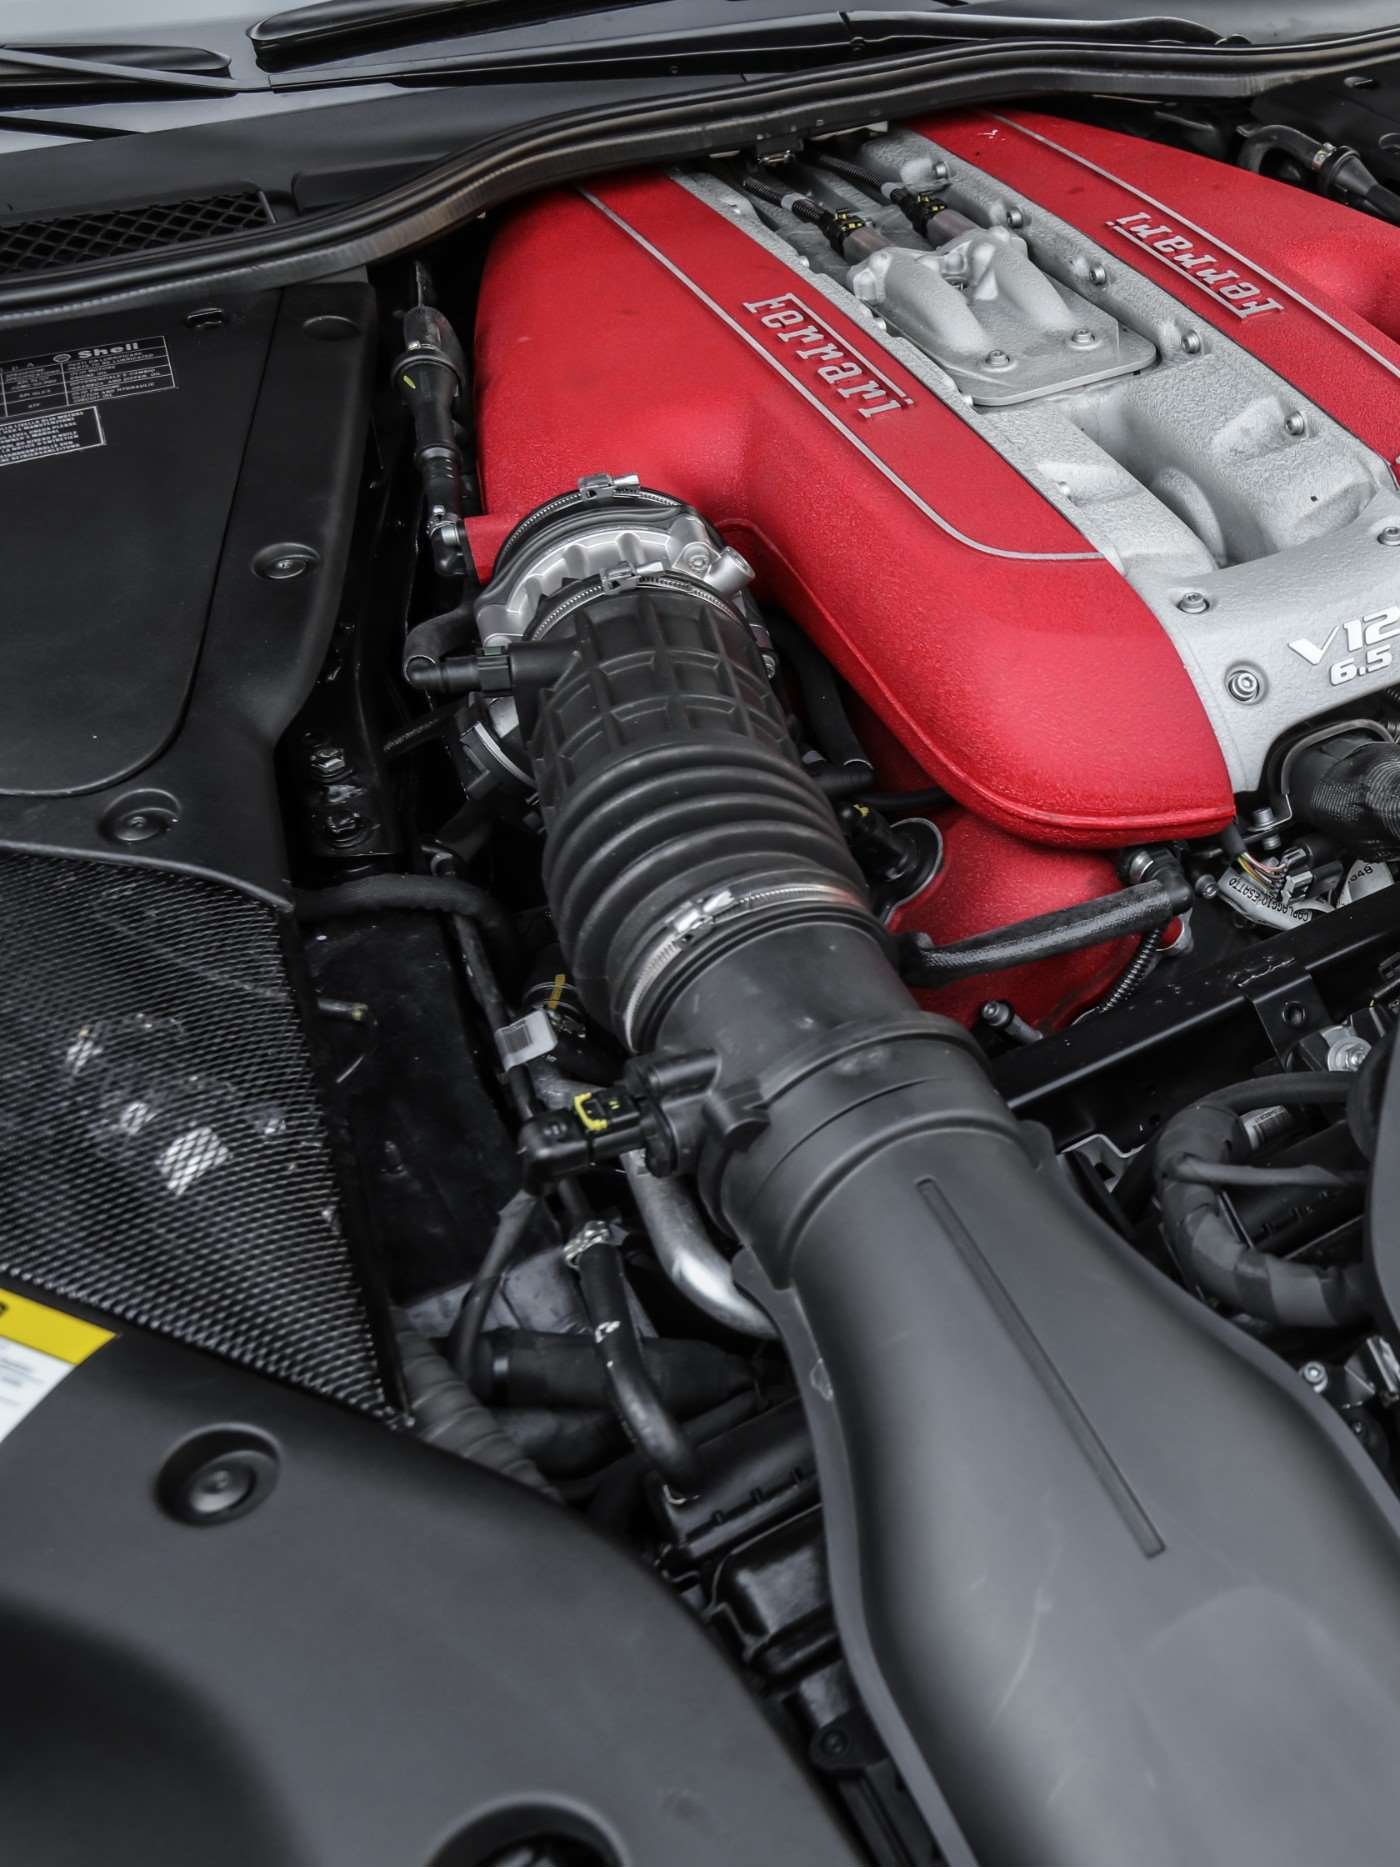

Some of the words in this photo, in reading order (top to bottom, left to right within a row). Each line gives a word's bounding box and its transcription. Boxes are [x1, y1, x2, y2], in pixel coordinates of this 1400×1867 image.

[1105, 212, 1285, 320] Ferrari
[78, 342, 139, 359] Shell
[742, 292, 914, 418] Ferrari
[1329, 644, 1393, 687] 6.5
